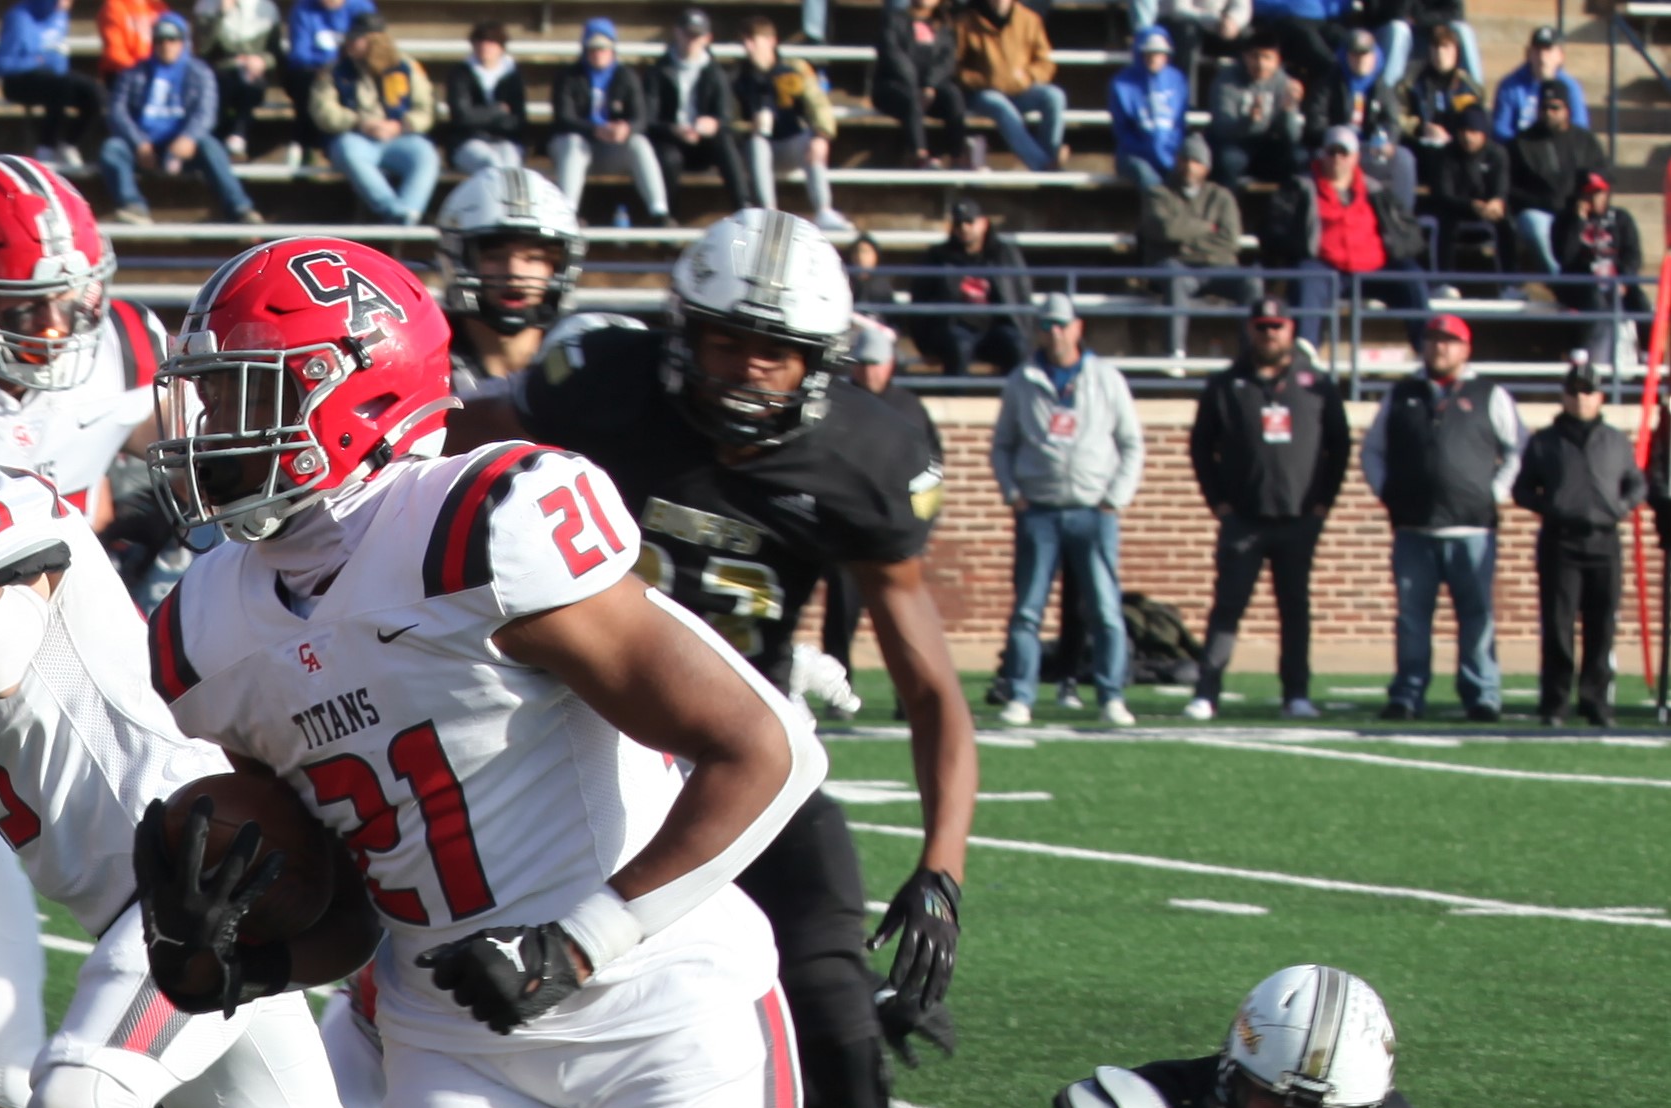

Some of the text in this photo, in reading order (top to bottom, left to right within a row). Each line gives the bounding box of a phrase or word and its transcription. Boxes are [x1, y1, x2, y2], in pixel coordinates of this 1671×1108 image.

[287, 249, 408, 337] CA
[536, 470, 627, 580] 21
[298, 642, 322, 673] CA
[291, 687, 380, 750] TITANS
[300, 718, 497, 927] 21
